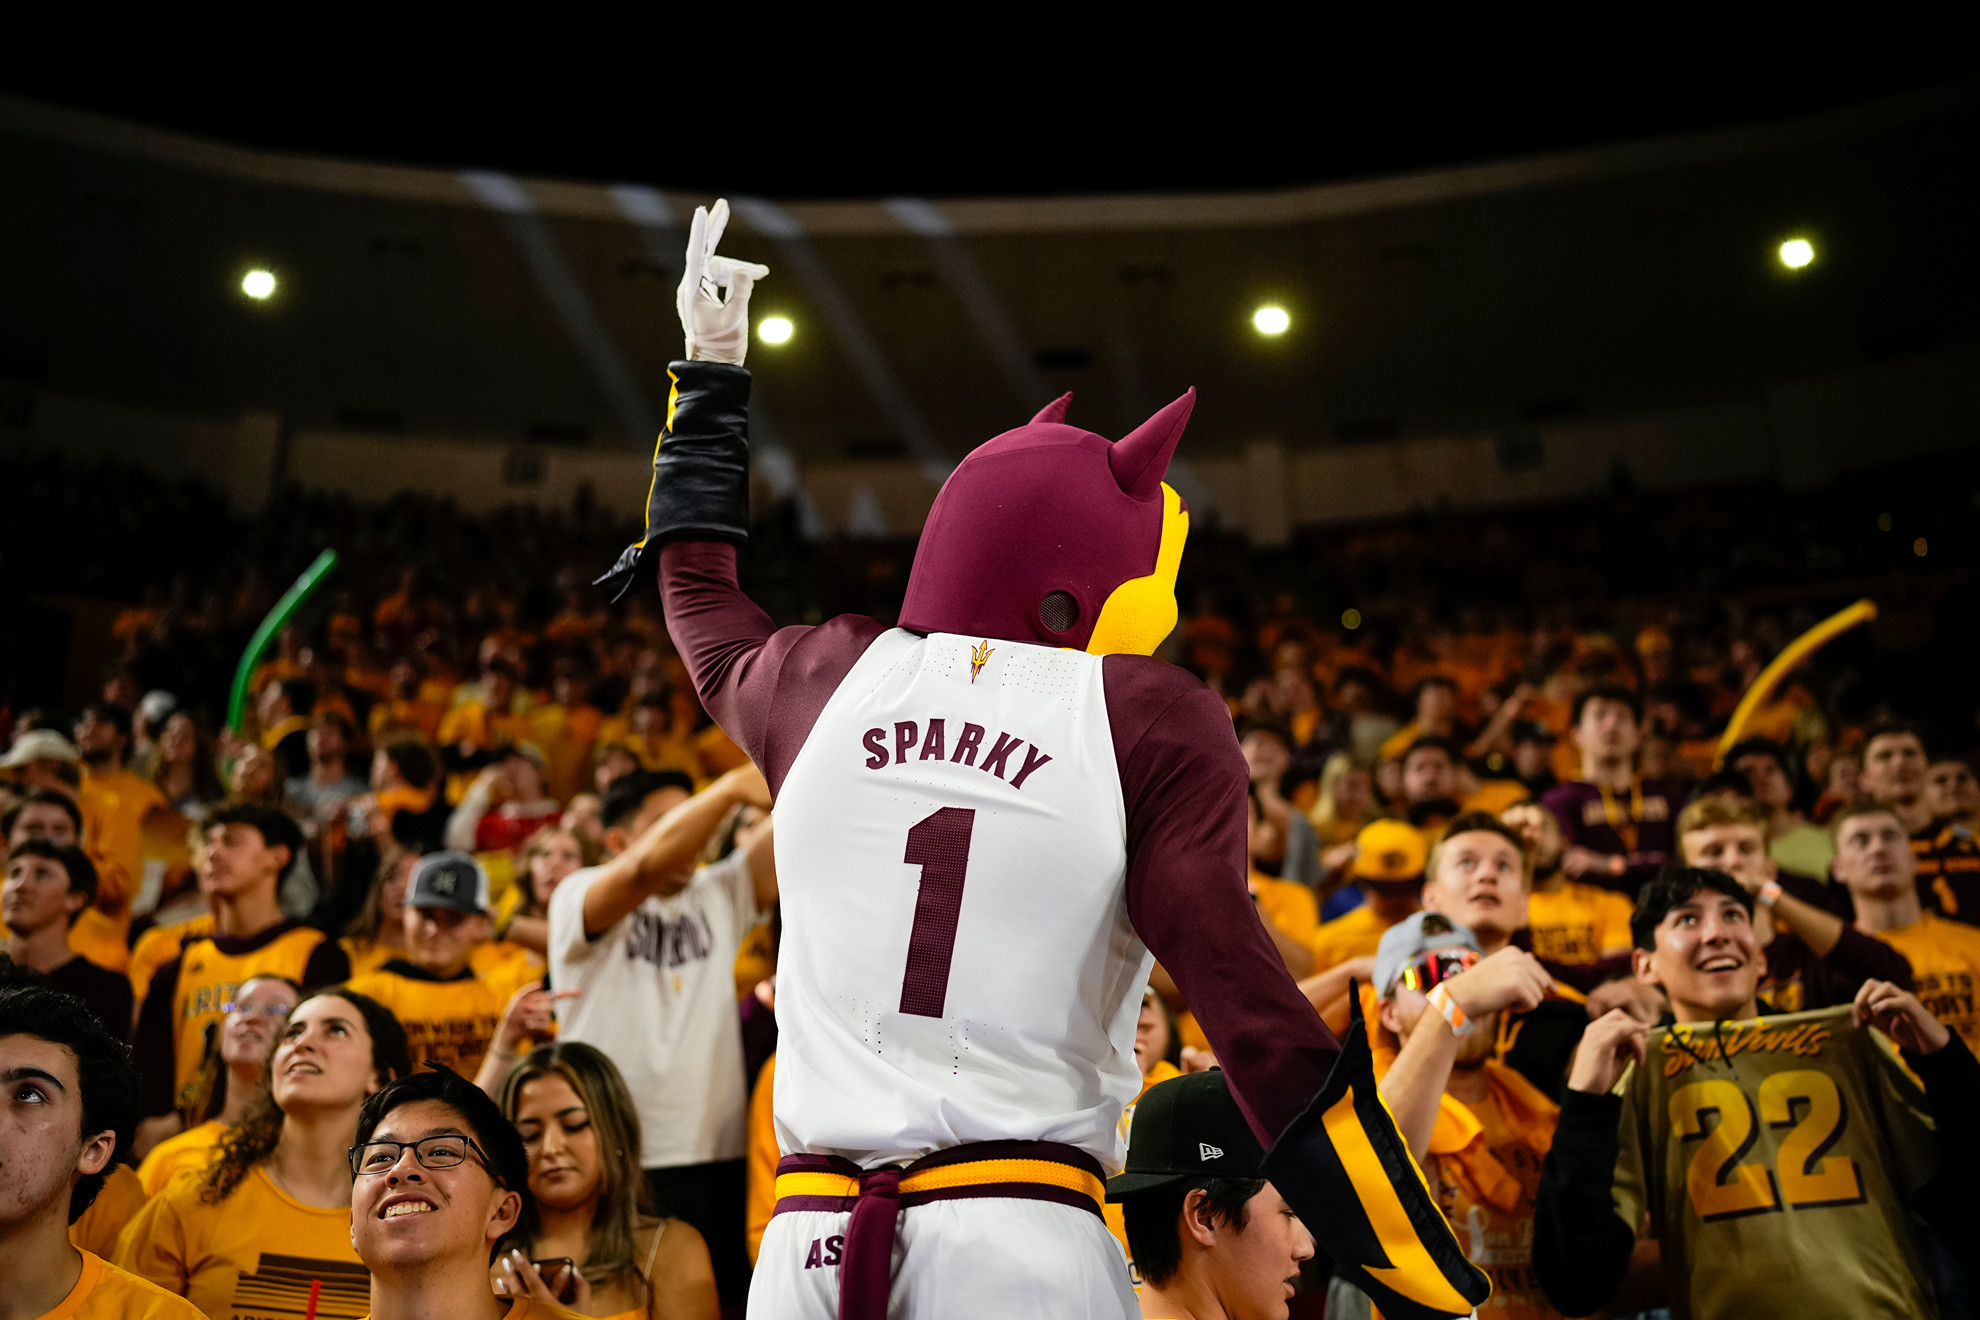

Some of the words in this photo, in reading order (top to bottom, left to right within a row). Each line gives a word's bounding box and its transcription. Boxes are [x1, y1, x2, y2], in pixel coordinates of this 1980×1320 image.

[862, 718, 1053, 790] SPARKY
[899, 806, 976, 1019] 1
[1668, 1069, 1868, 1223] 22
[804, 1235, 845, 1269] AS
